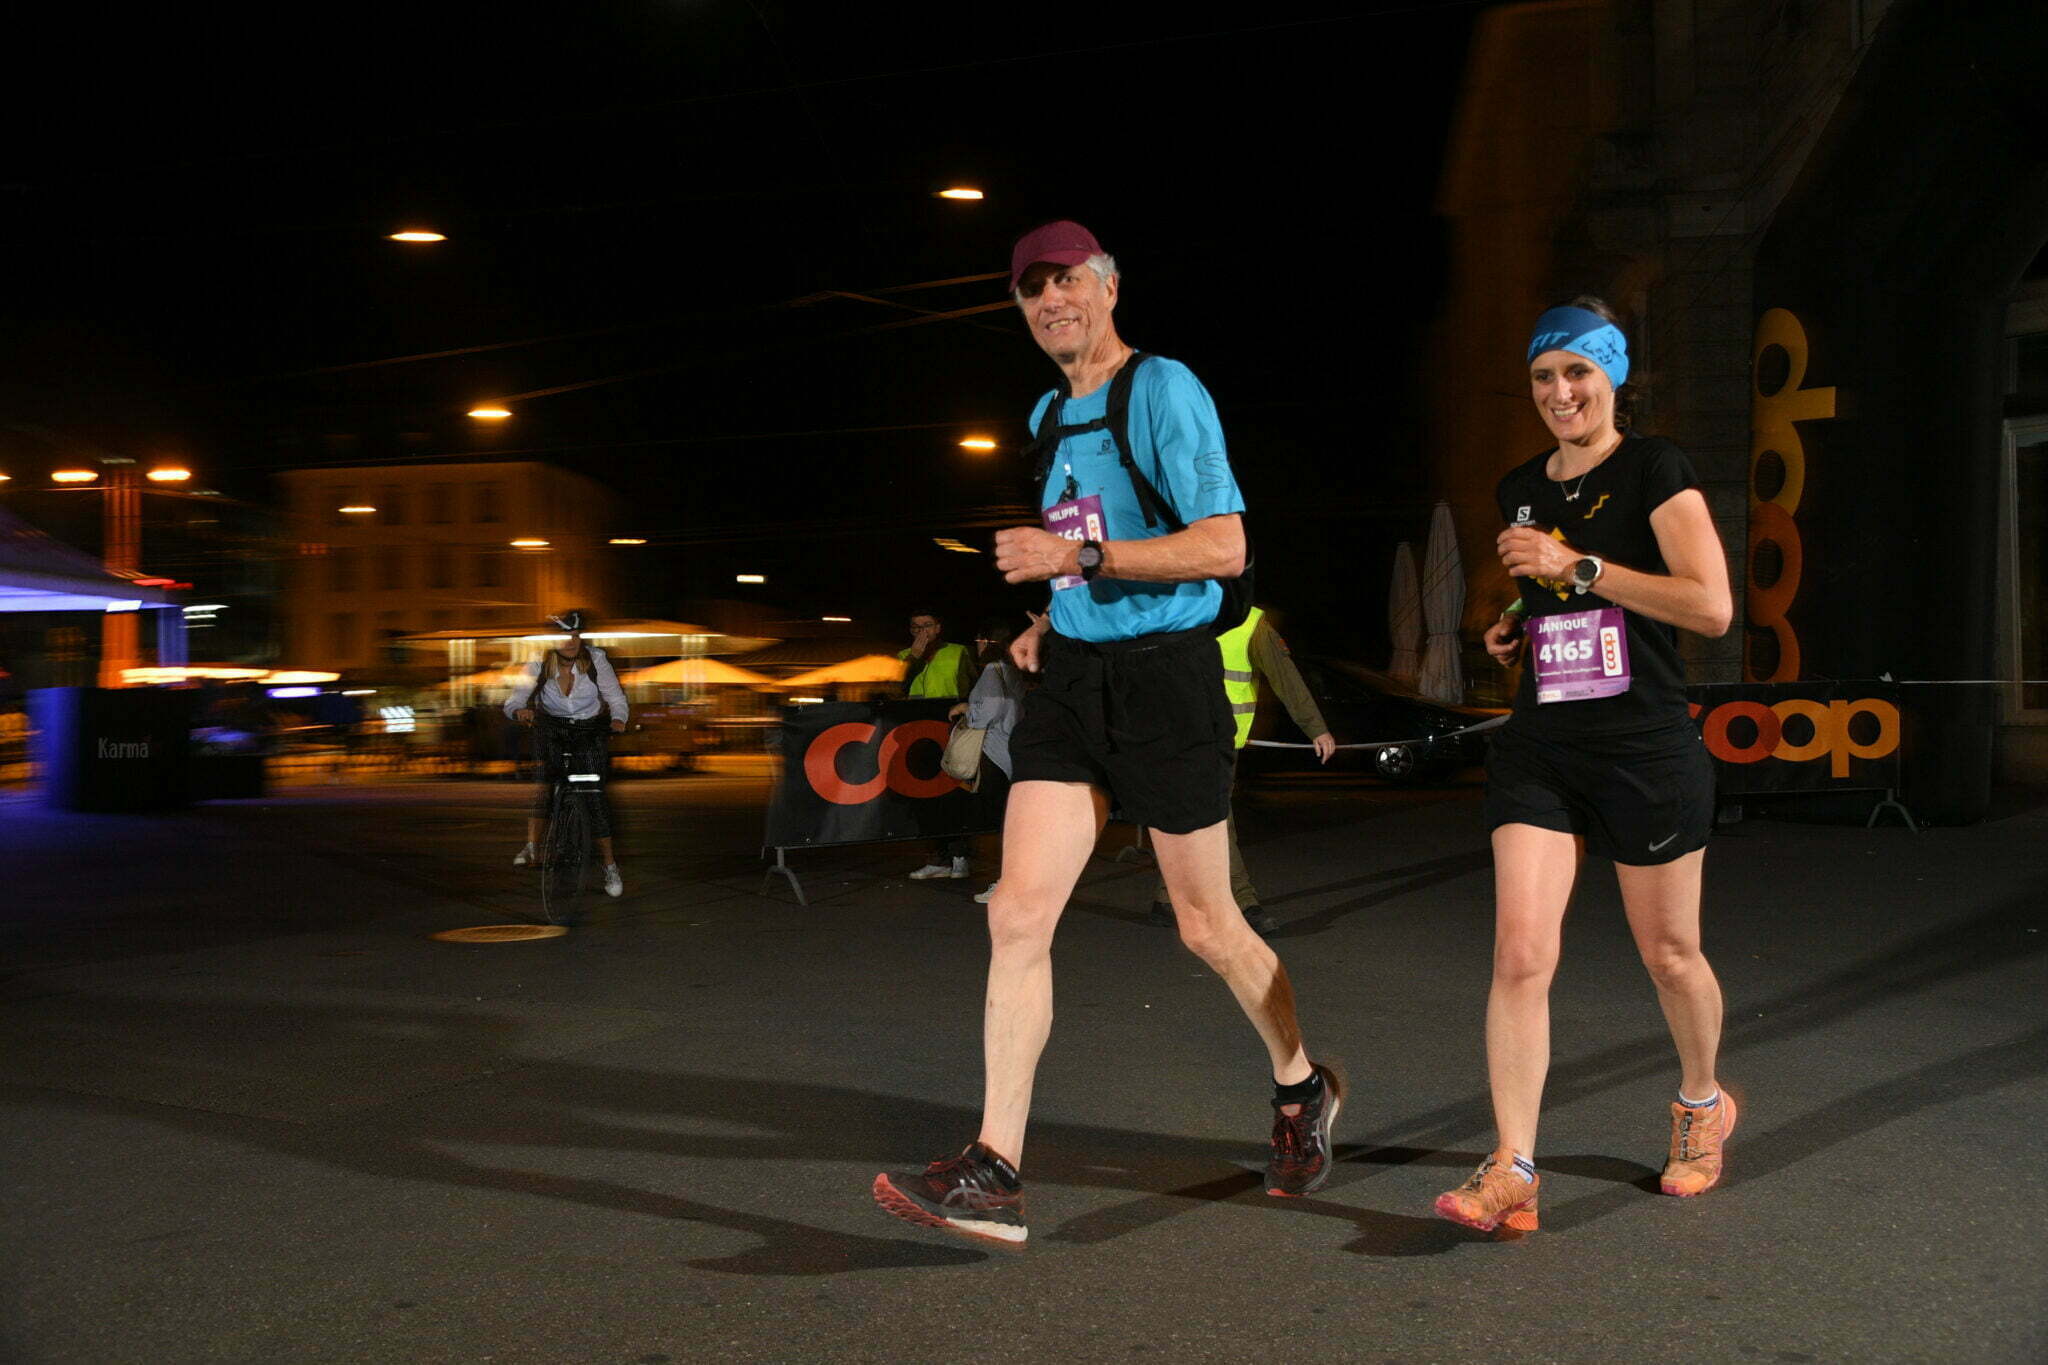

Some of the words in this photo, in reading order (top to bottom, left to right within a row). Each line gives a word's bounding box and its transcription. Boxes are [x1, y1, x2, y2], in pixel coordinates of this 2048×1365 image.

[1538, 618, 1588, 634] JANIQUE
[1540, 640, 1593, 663] 4165
[1604, 633, 1616, 670] coop
[98, 737, 149, 759] Karma
[1687, 698, 1900, 778] oop
